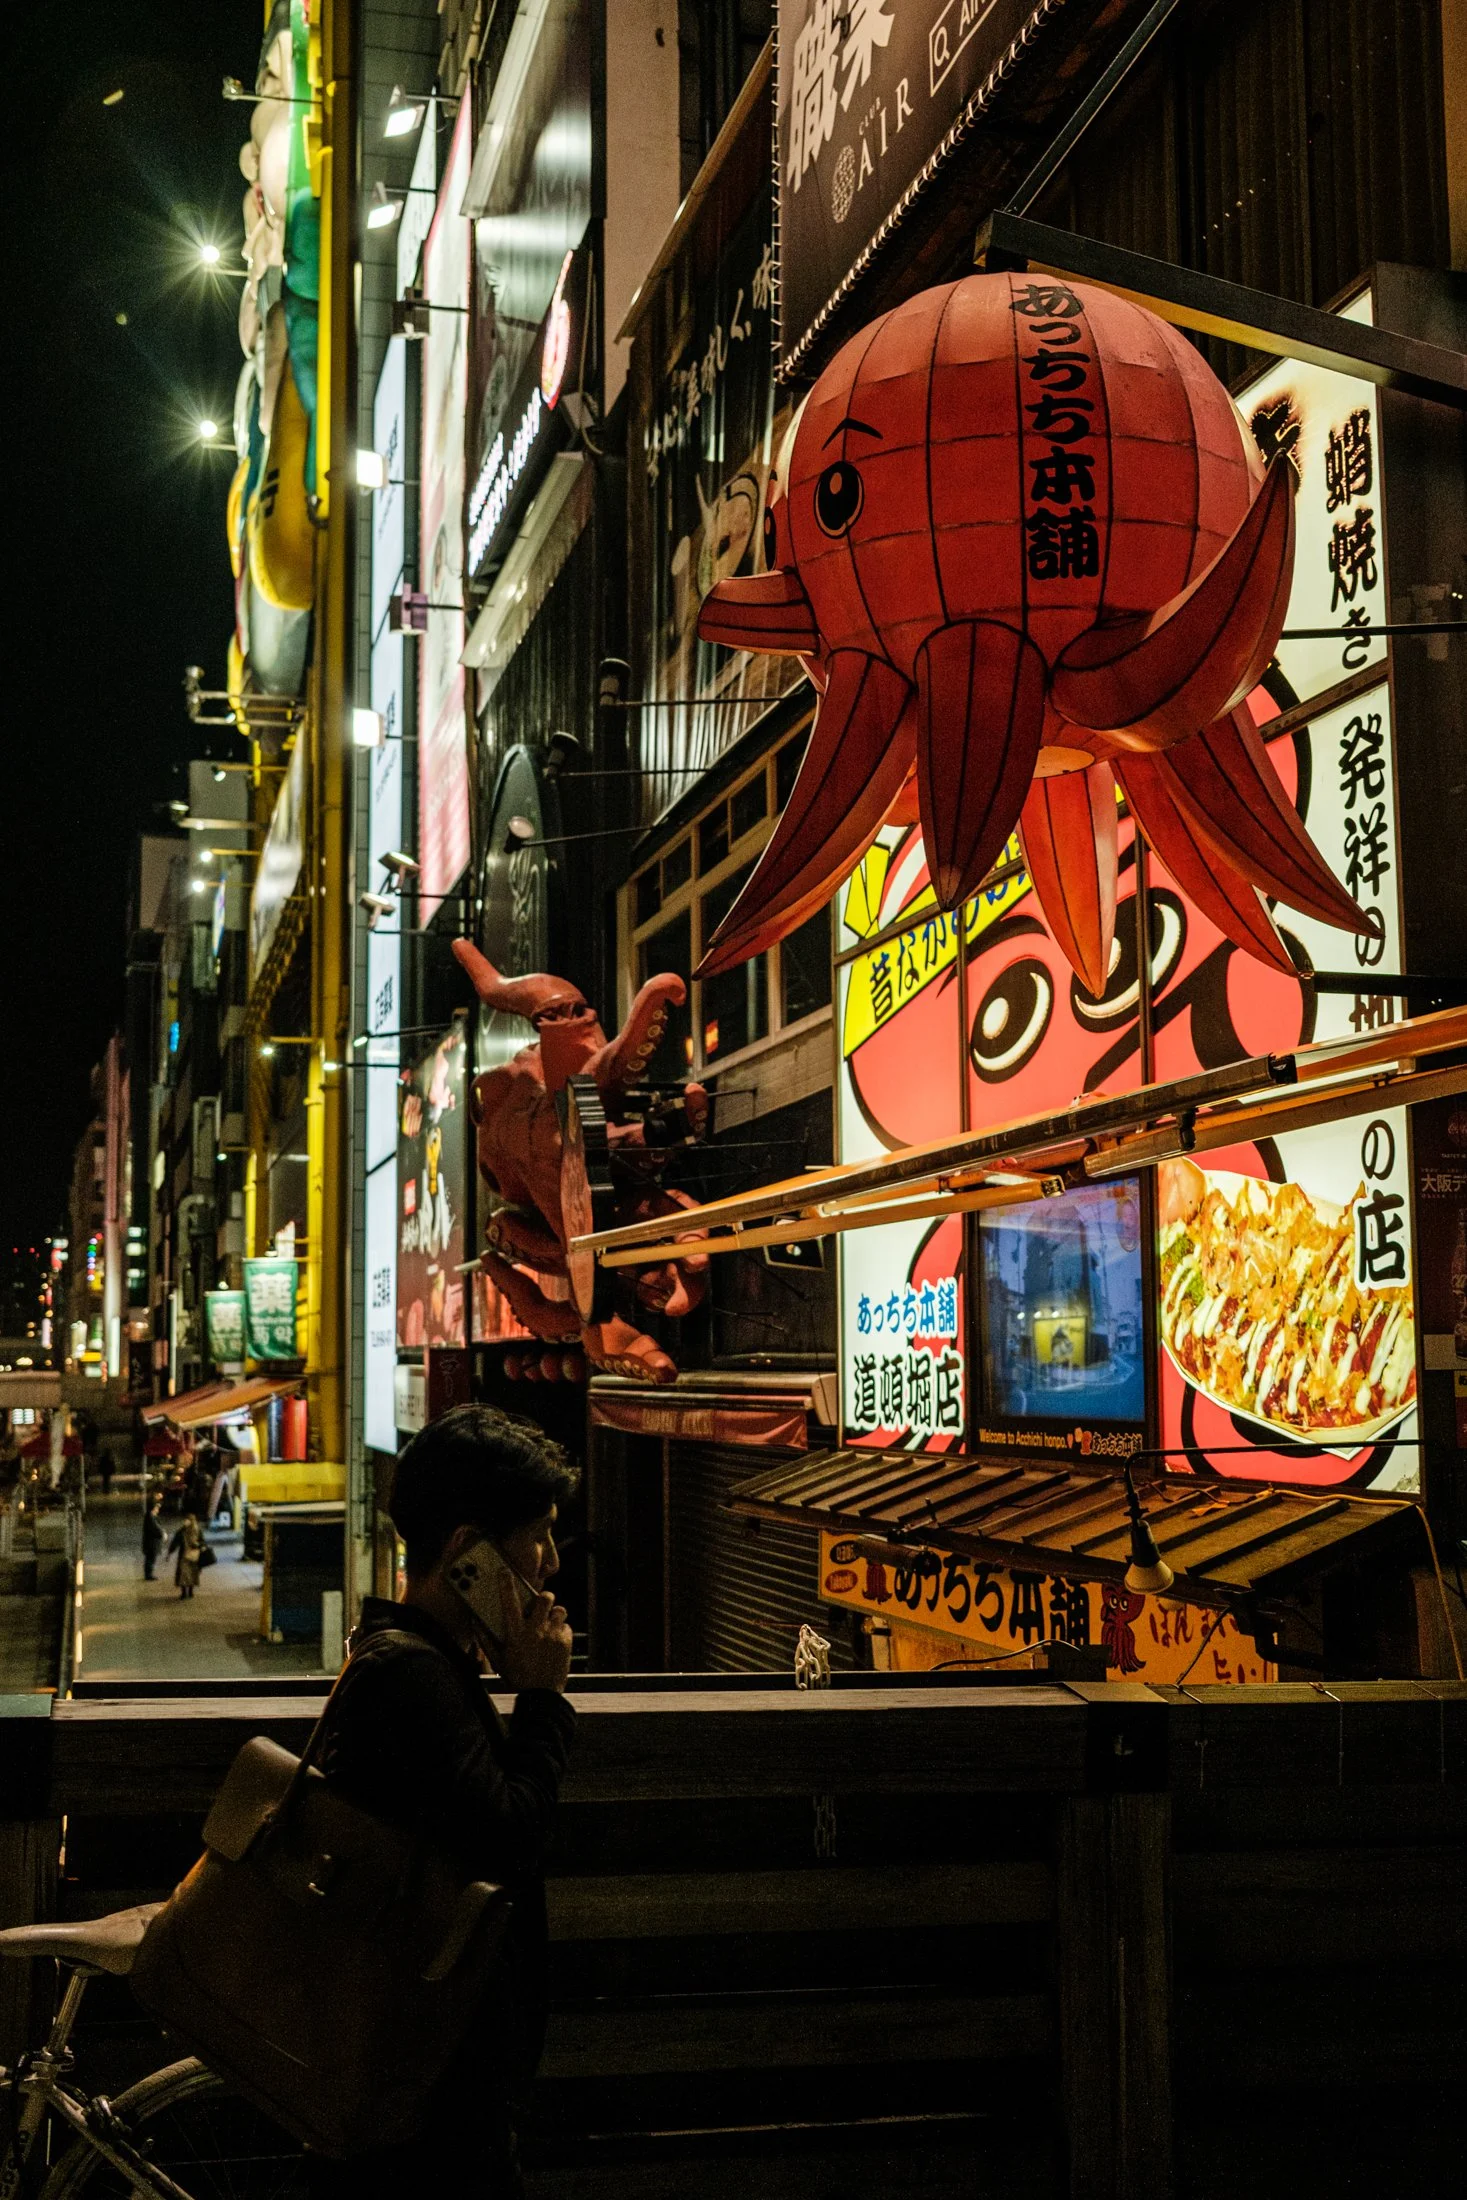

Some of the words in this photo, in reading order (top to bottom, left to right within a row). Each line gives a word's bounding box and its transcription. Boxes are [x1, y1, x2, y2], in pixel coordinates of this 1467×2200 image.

[856, 77, 914, 192] AIR
[1009, 283, 1100, 580] あっちち本舗
[857, 1283, 955, 1335] あっちち本舗
[854, 1350, 961, 1429] 道頓堀店
[979, 1428, 1006, 1443] Welcome
